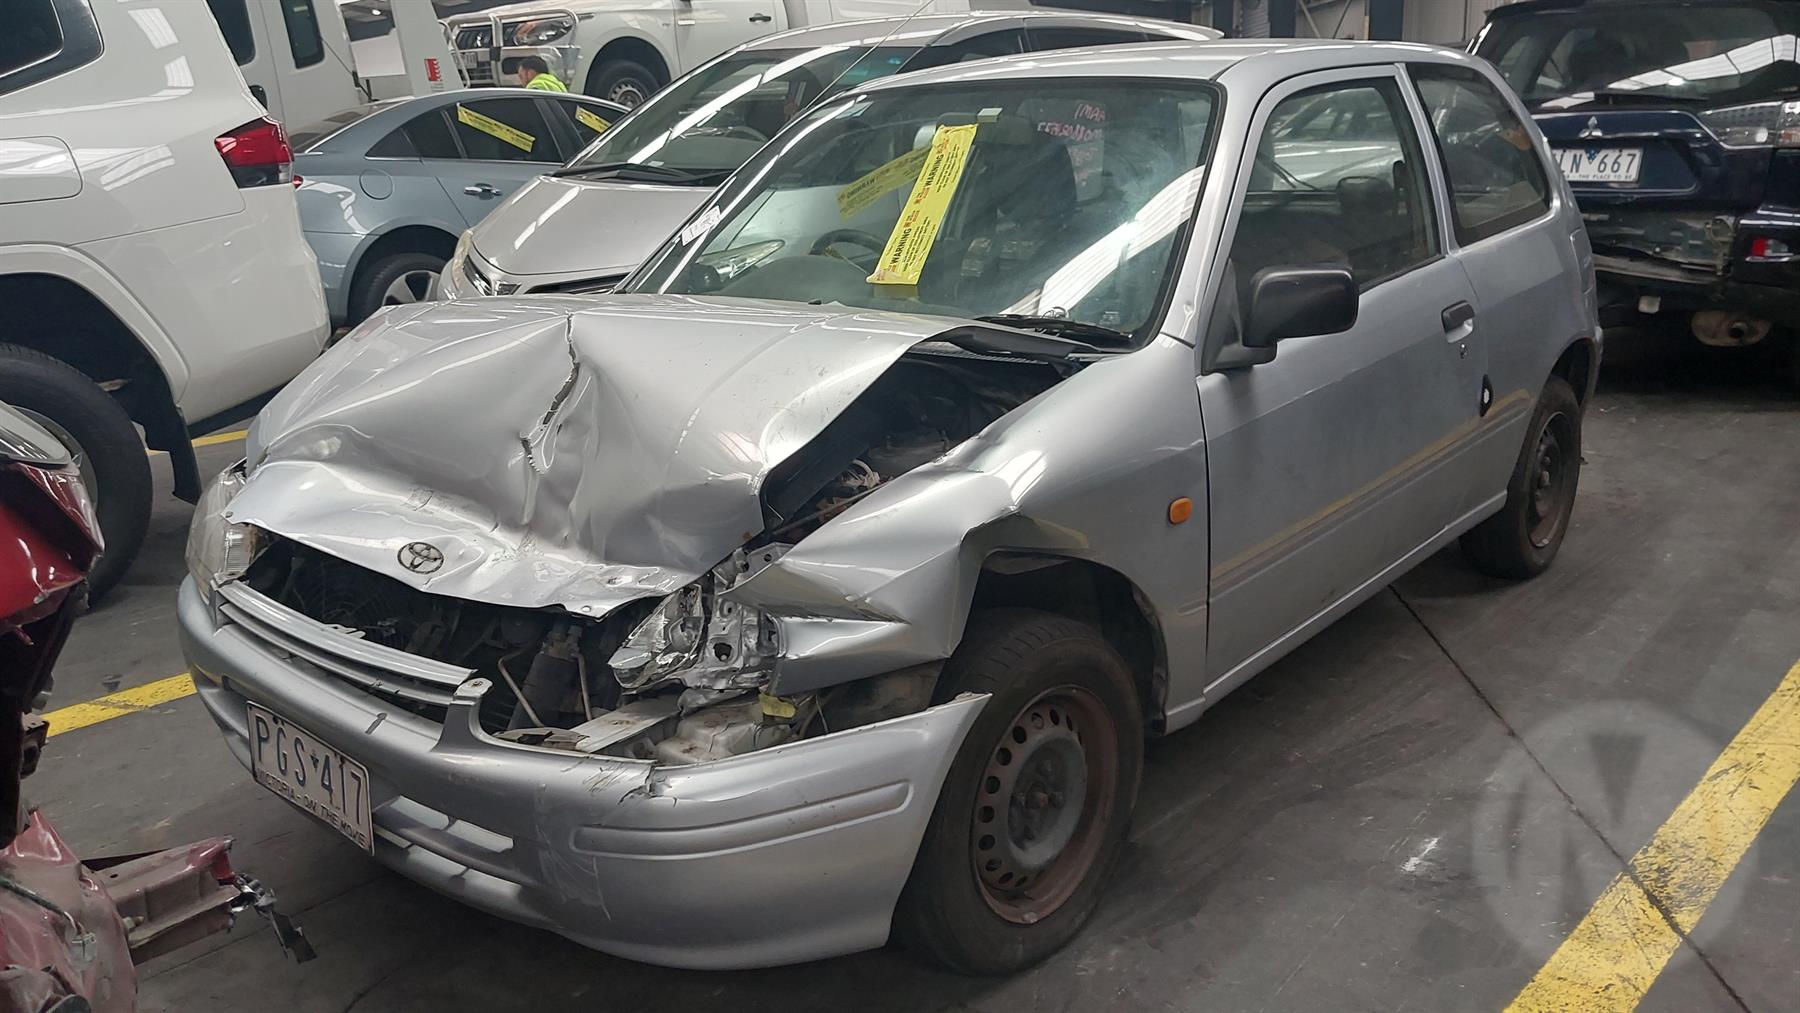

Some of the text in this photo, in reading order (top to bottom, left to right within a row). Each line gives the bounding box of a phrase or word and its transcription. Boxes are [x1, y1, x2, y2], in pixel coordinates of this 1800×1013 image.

[925, 154, 945, 186] WARNING
[1553, 153, 1637, 173] LN 667
[890, 228, 912, 264] WARNING
[255, 714, 362, 825] PGS 417
[321, 803, 340, 826] THE
[341, 819, 369, 847] MOVE
